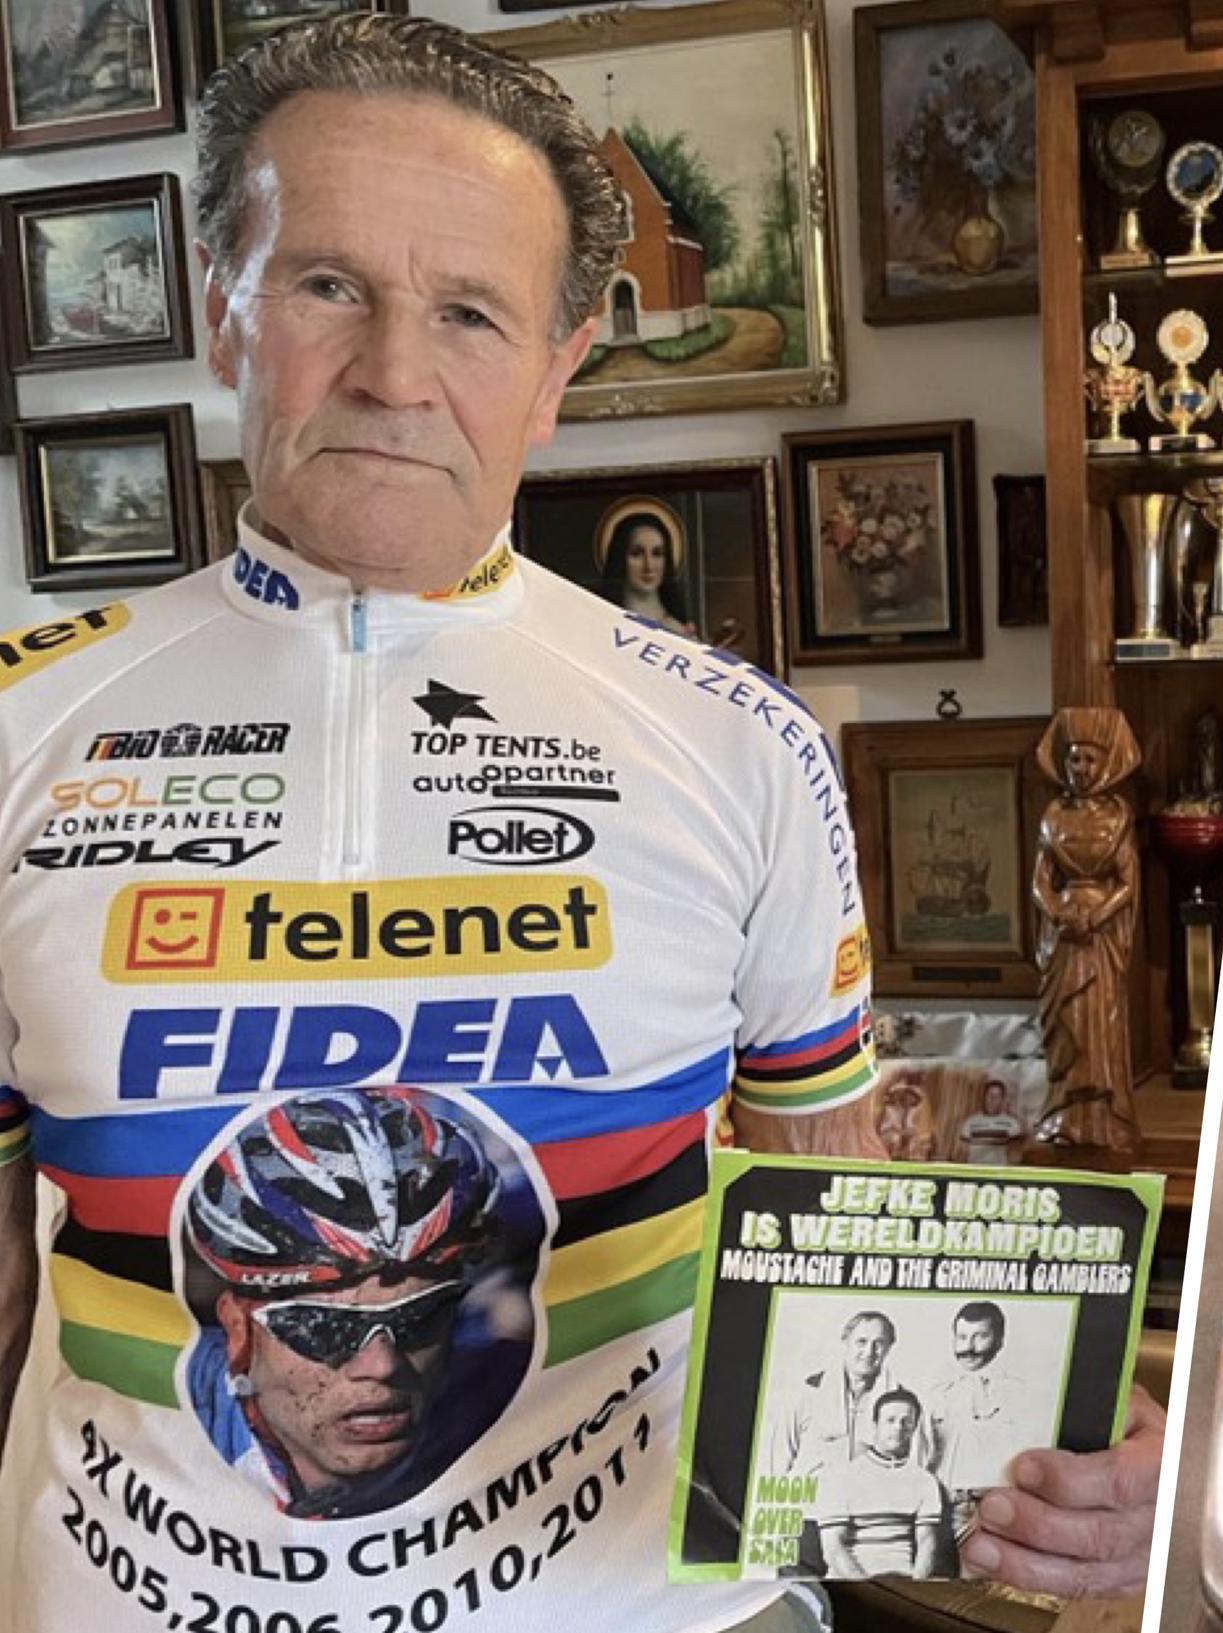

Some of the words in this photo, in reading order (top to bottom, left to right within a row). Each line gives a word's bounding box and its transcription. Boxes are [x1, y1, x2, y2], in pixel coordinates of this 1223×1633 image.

[200, 722, 291, 756] RACER
[411, 731, 468, 756] TOP
[476, 734, 602, 762] TENTS.be
[613, 627, 856, 916] VERZEKERINGEN
[50, 772, 286, 811] SOLECO
[42, 810, 284, 838] ZONNEPANELEN
[448, 819, 569, 856] Pollet
[12, 837, 282, 873] RIDLEY
[244, 885, 598, 961] telenet
[118, 993, 610, 1100] FIDEA
[819, 1175, 937, 1218] JEFKE
[945, 1180, 1061, 1223] MORIS
[740, 1211, 782, 1250] IS
[790, 1213, 1124, 1261] WERELDKAMPIOEN
[720, 1249, 846, 1285] MOUSTACHE
[848, 1255, 893, 1287] AND
[895, 1257, 932, 1290] THE
[934, 1260, 1029, 1291] CRIMINAL
[1031, 1263, 1132, 1294] GAMBLERS
[124, 1468, 329, 1583] WORLD
[347, 1348, 661, 1578] CHAMPION
[757, 1475, 818, 1504] MOON
[752, 1507, 803, 1536] OVER
